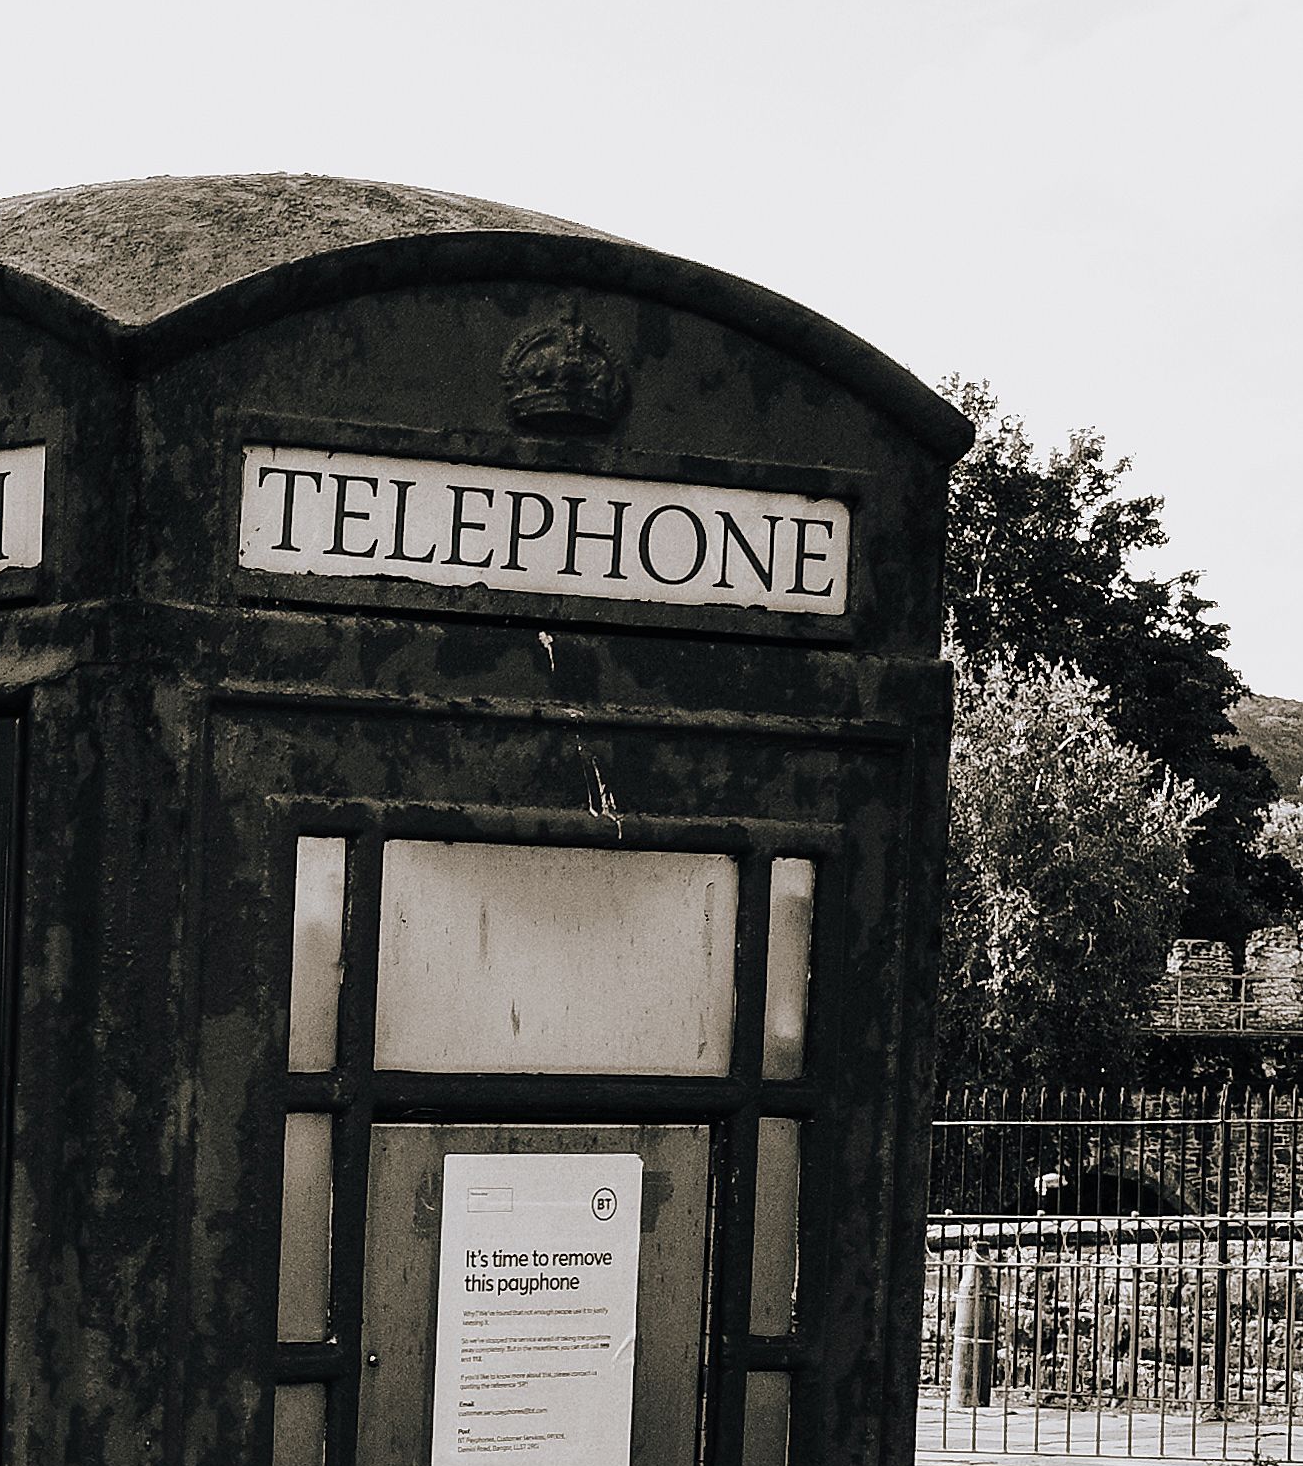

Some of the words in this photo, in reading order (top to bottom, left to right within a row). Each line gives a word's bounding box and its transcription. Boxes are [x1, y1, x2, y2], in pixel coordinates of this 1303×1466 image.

[258, 466, 835, 598] TELEPHONE
[597, 1198, 612, 1210] BT
[466, 1250, 489, 1268] It's
[492, 1250, 528, 1267] time
[532, 1250, 549, 1267] to
[552, 1252, 613, 1266] remove
[465, 1274, 494, 1292] this
[497, 1272, 580, 1296] payphone
